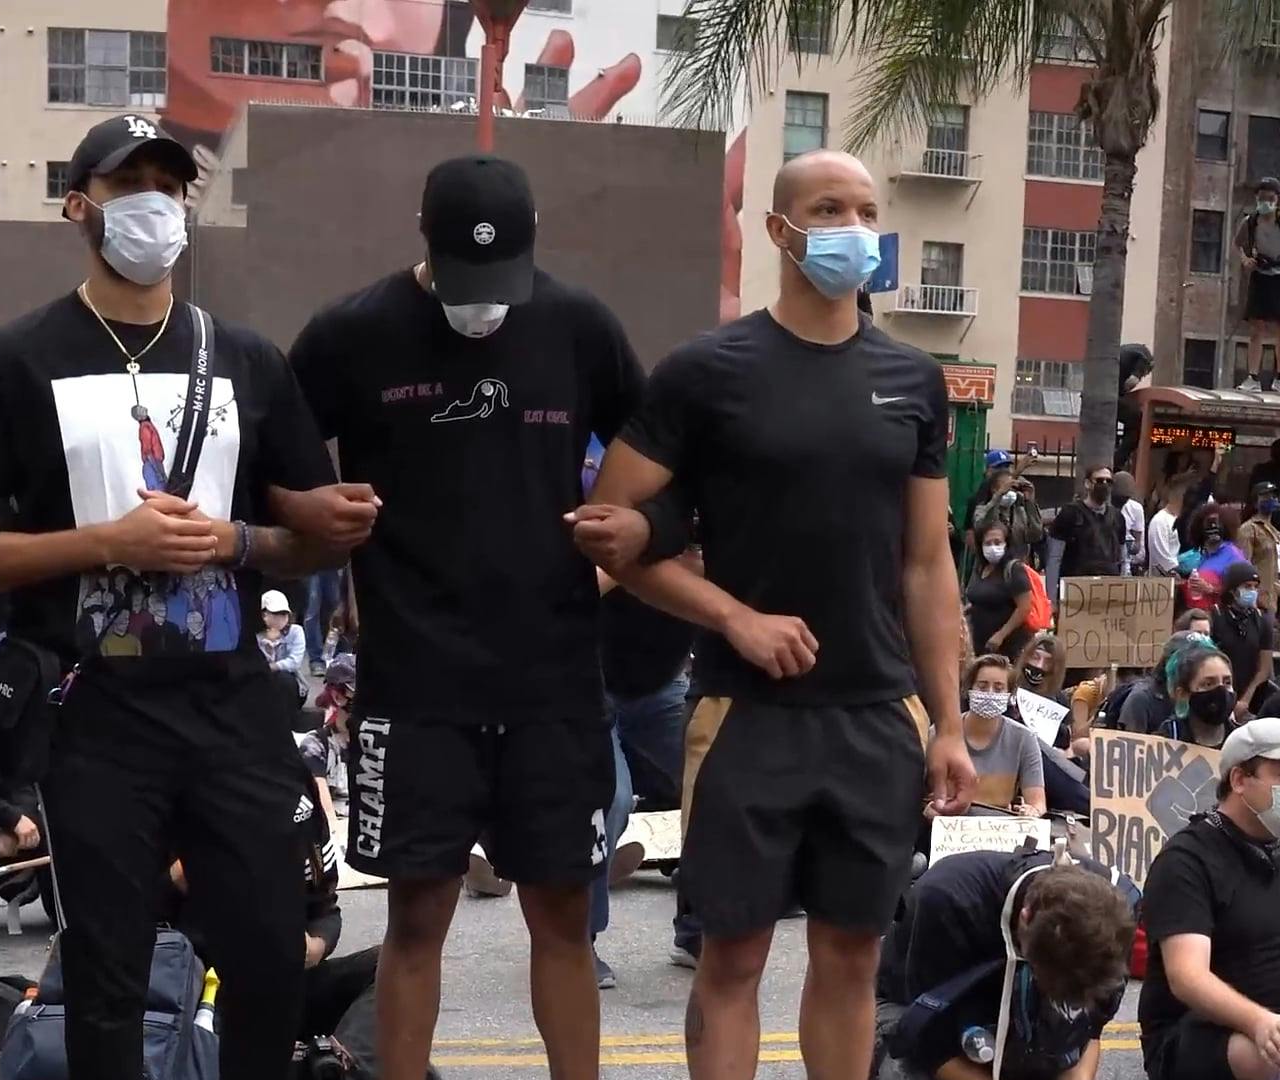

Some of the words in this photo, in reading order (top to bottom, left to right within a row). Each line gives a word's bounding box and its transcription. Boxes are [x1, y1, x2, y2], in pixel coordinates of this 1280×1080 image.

[124, 116, 157, 139] LA
[198, 347, 208, 376] NOIR
[1065, 582, 1170, 618] DEFUND
[1102, 618, 1126, 631] THE
[356, 716, 391, 859] CHAMPI
[939, 818, 969, 832] WE
